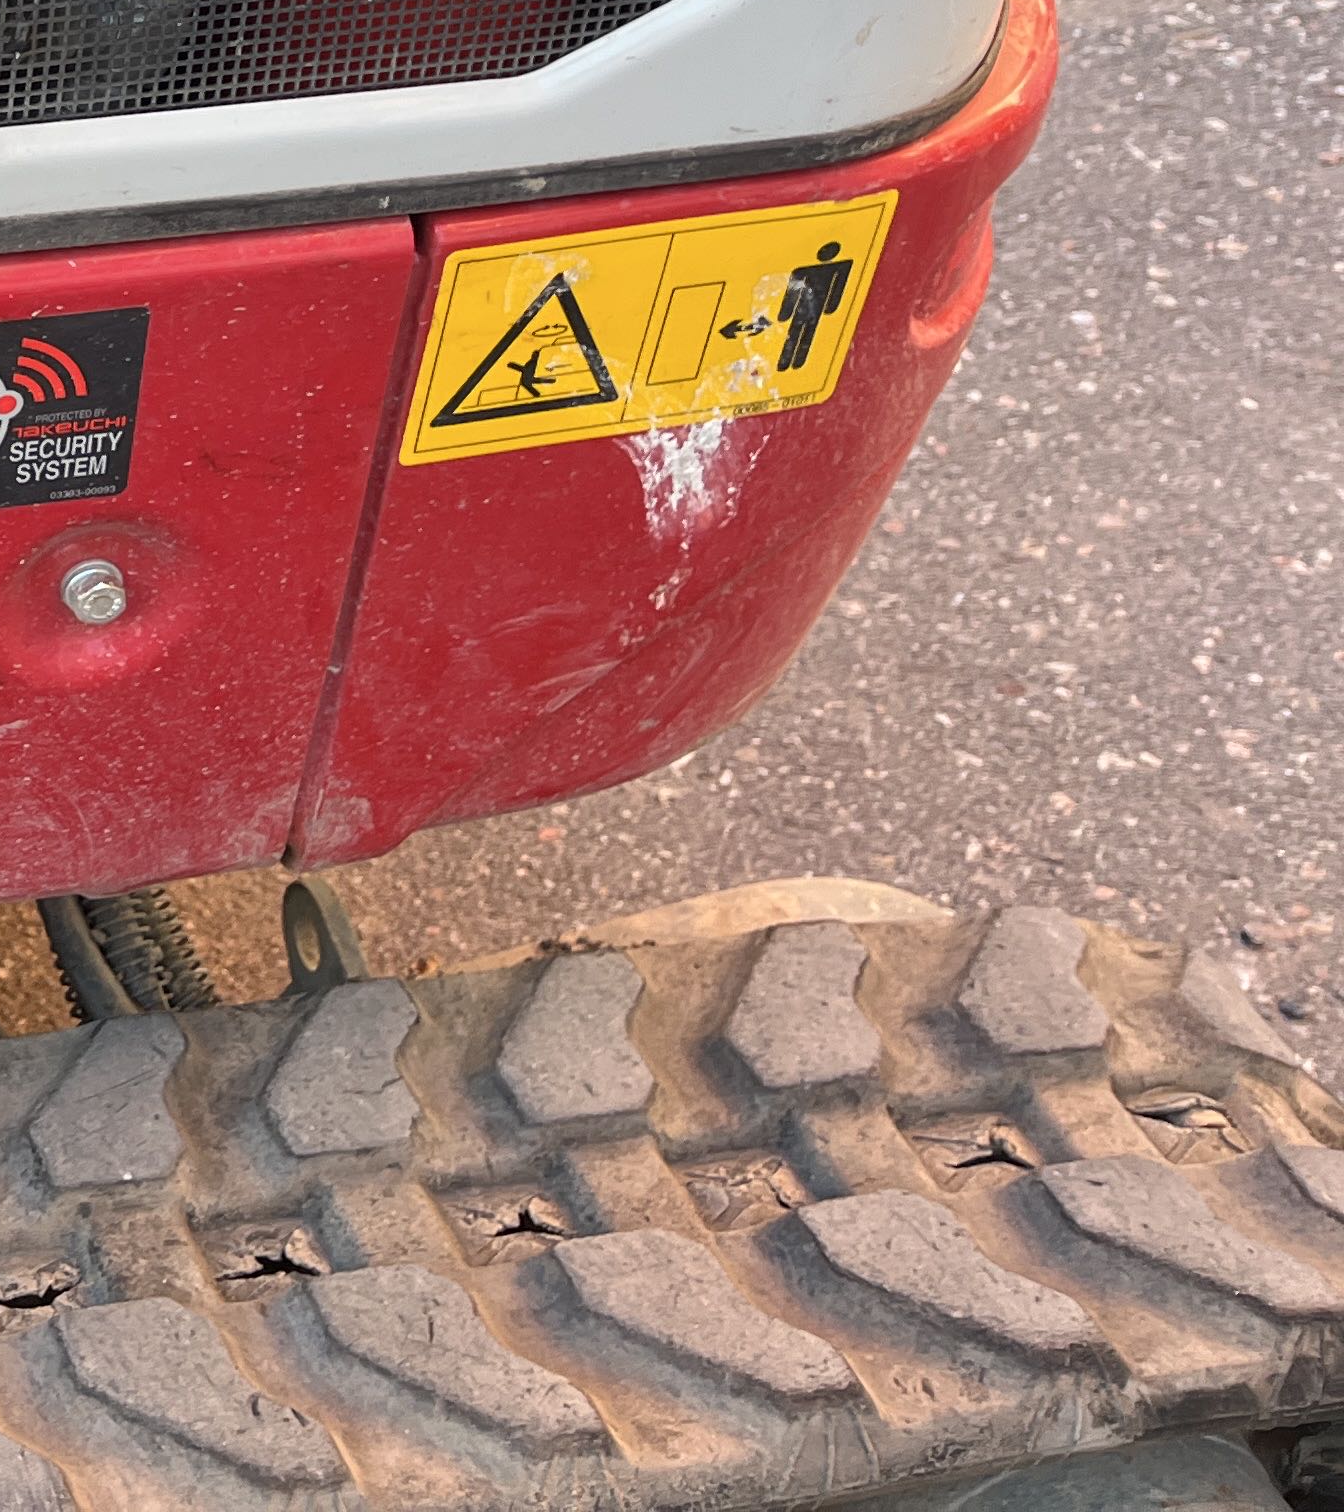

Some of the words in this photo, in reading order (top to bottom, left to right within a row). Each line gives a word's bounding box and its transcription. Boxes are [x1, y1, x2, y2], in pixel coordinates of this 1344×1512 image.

[35, 410, 93, 423] PROTECTED
[94, 408, 107, 418] BY
[10, 431, 123, 463] SECURITY
[16, 455, 107, 484] SYSTEM
